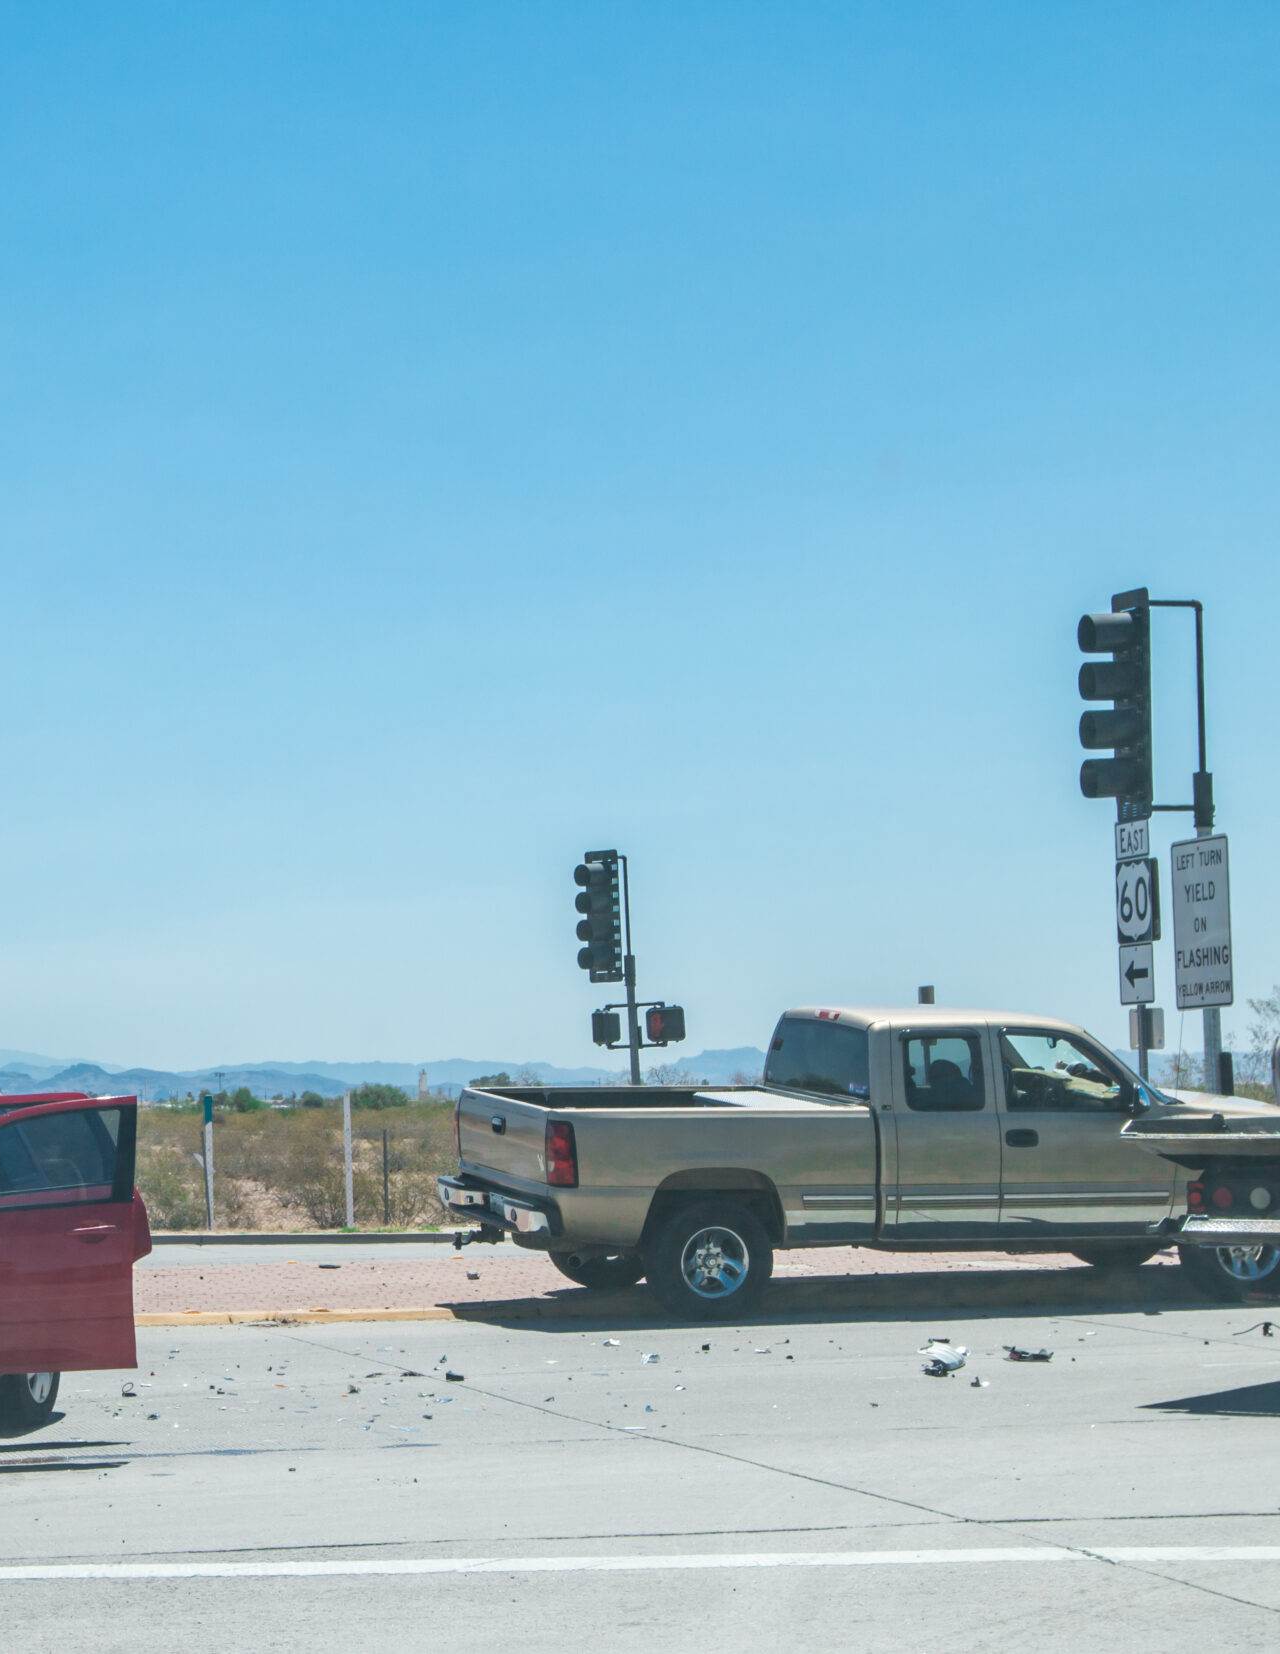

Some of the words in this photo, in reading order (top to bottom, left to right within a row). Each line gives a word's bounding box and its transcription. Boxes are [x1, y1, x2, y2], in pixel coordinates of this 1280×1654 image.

[1120, 828, 1144, 853] EAST
[1176, 853, 1195, 871] LEFT
[1199, 849, 1222, 867] TURN
[1121, 876, 1148, 923] 60
[1184, 881, 1215, 903] YIELD
[1194, 916, 1207, 933] ON
[1177, 945, 1229, 969] FLASHING
[1177, 982, 1203, 997] YELLOW
[1205, 980, 1231, 994] ARROW
